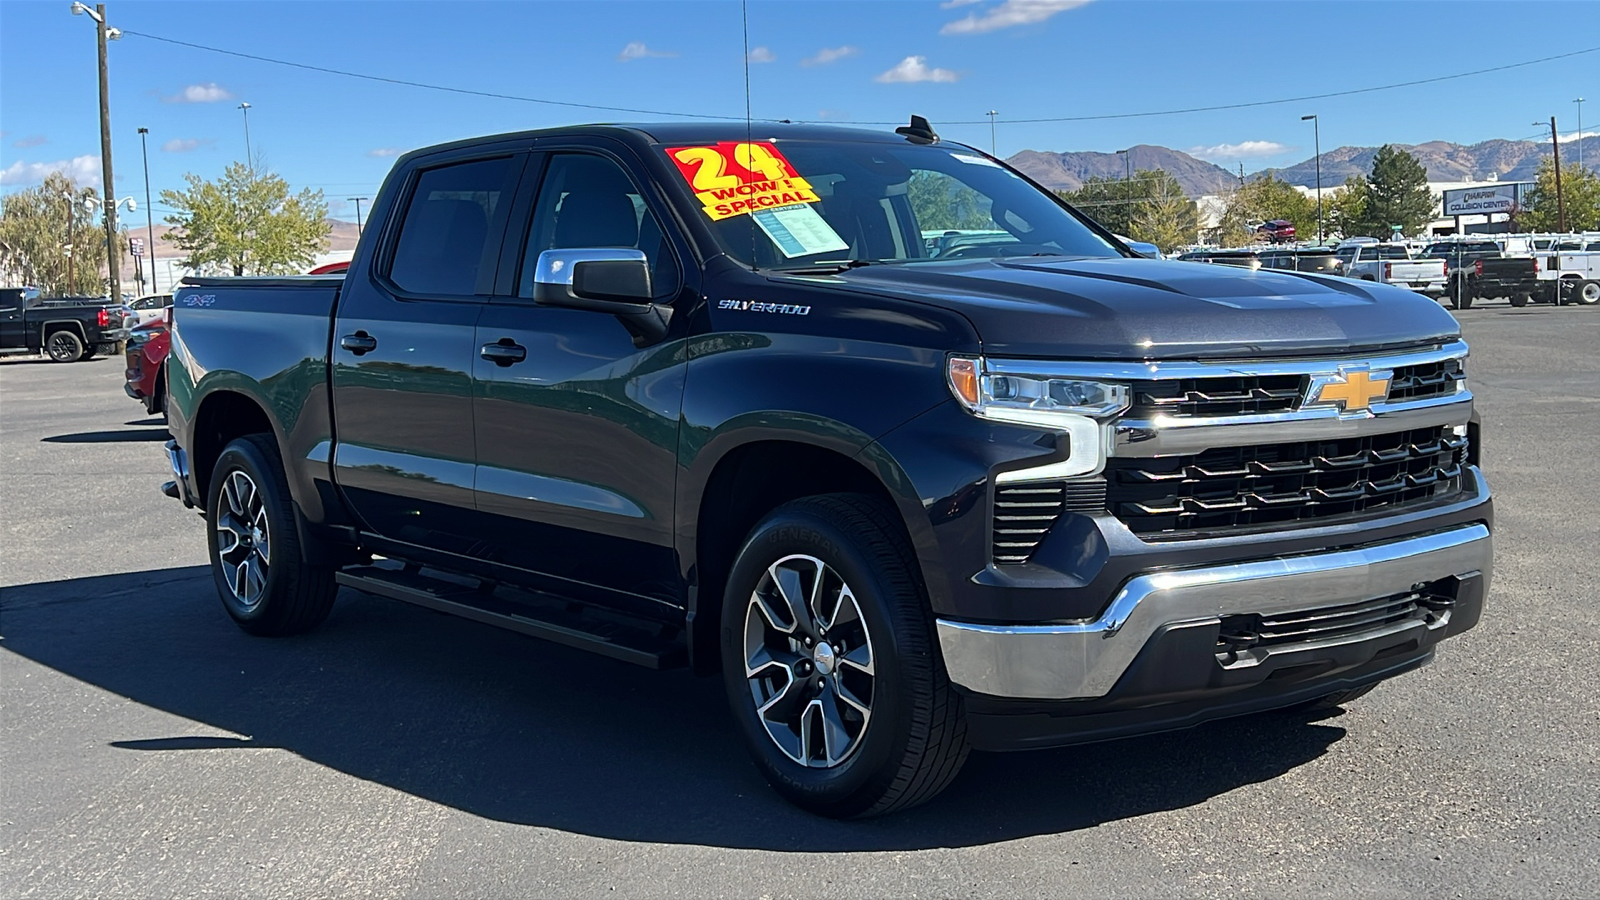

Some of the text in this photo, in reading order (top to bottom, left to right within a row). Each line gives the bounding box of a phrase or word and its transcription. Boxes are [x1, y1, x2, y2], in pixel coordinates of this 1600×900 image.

[674, 143, 788, 191] 24
[711, 180, 777, 200] WOW
[1464, 191, 1495, 202] CHAMPION
[714, 191, 811, 216] SPECIAL
[1451, 201, 1510, 211] COLLISION CENTER
[717, 299, 812, 316] SILVERADO
